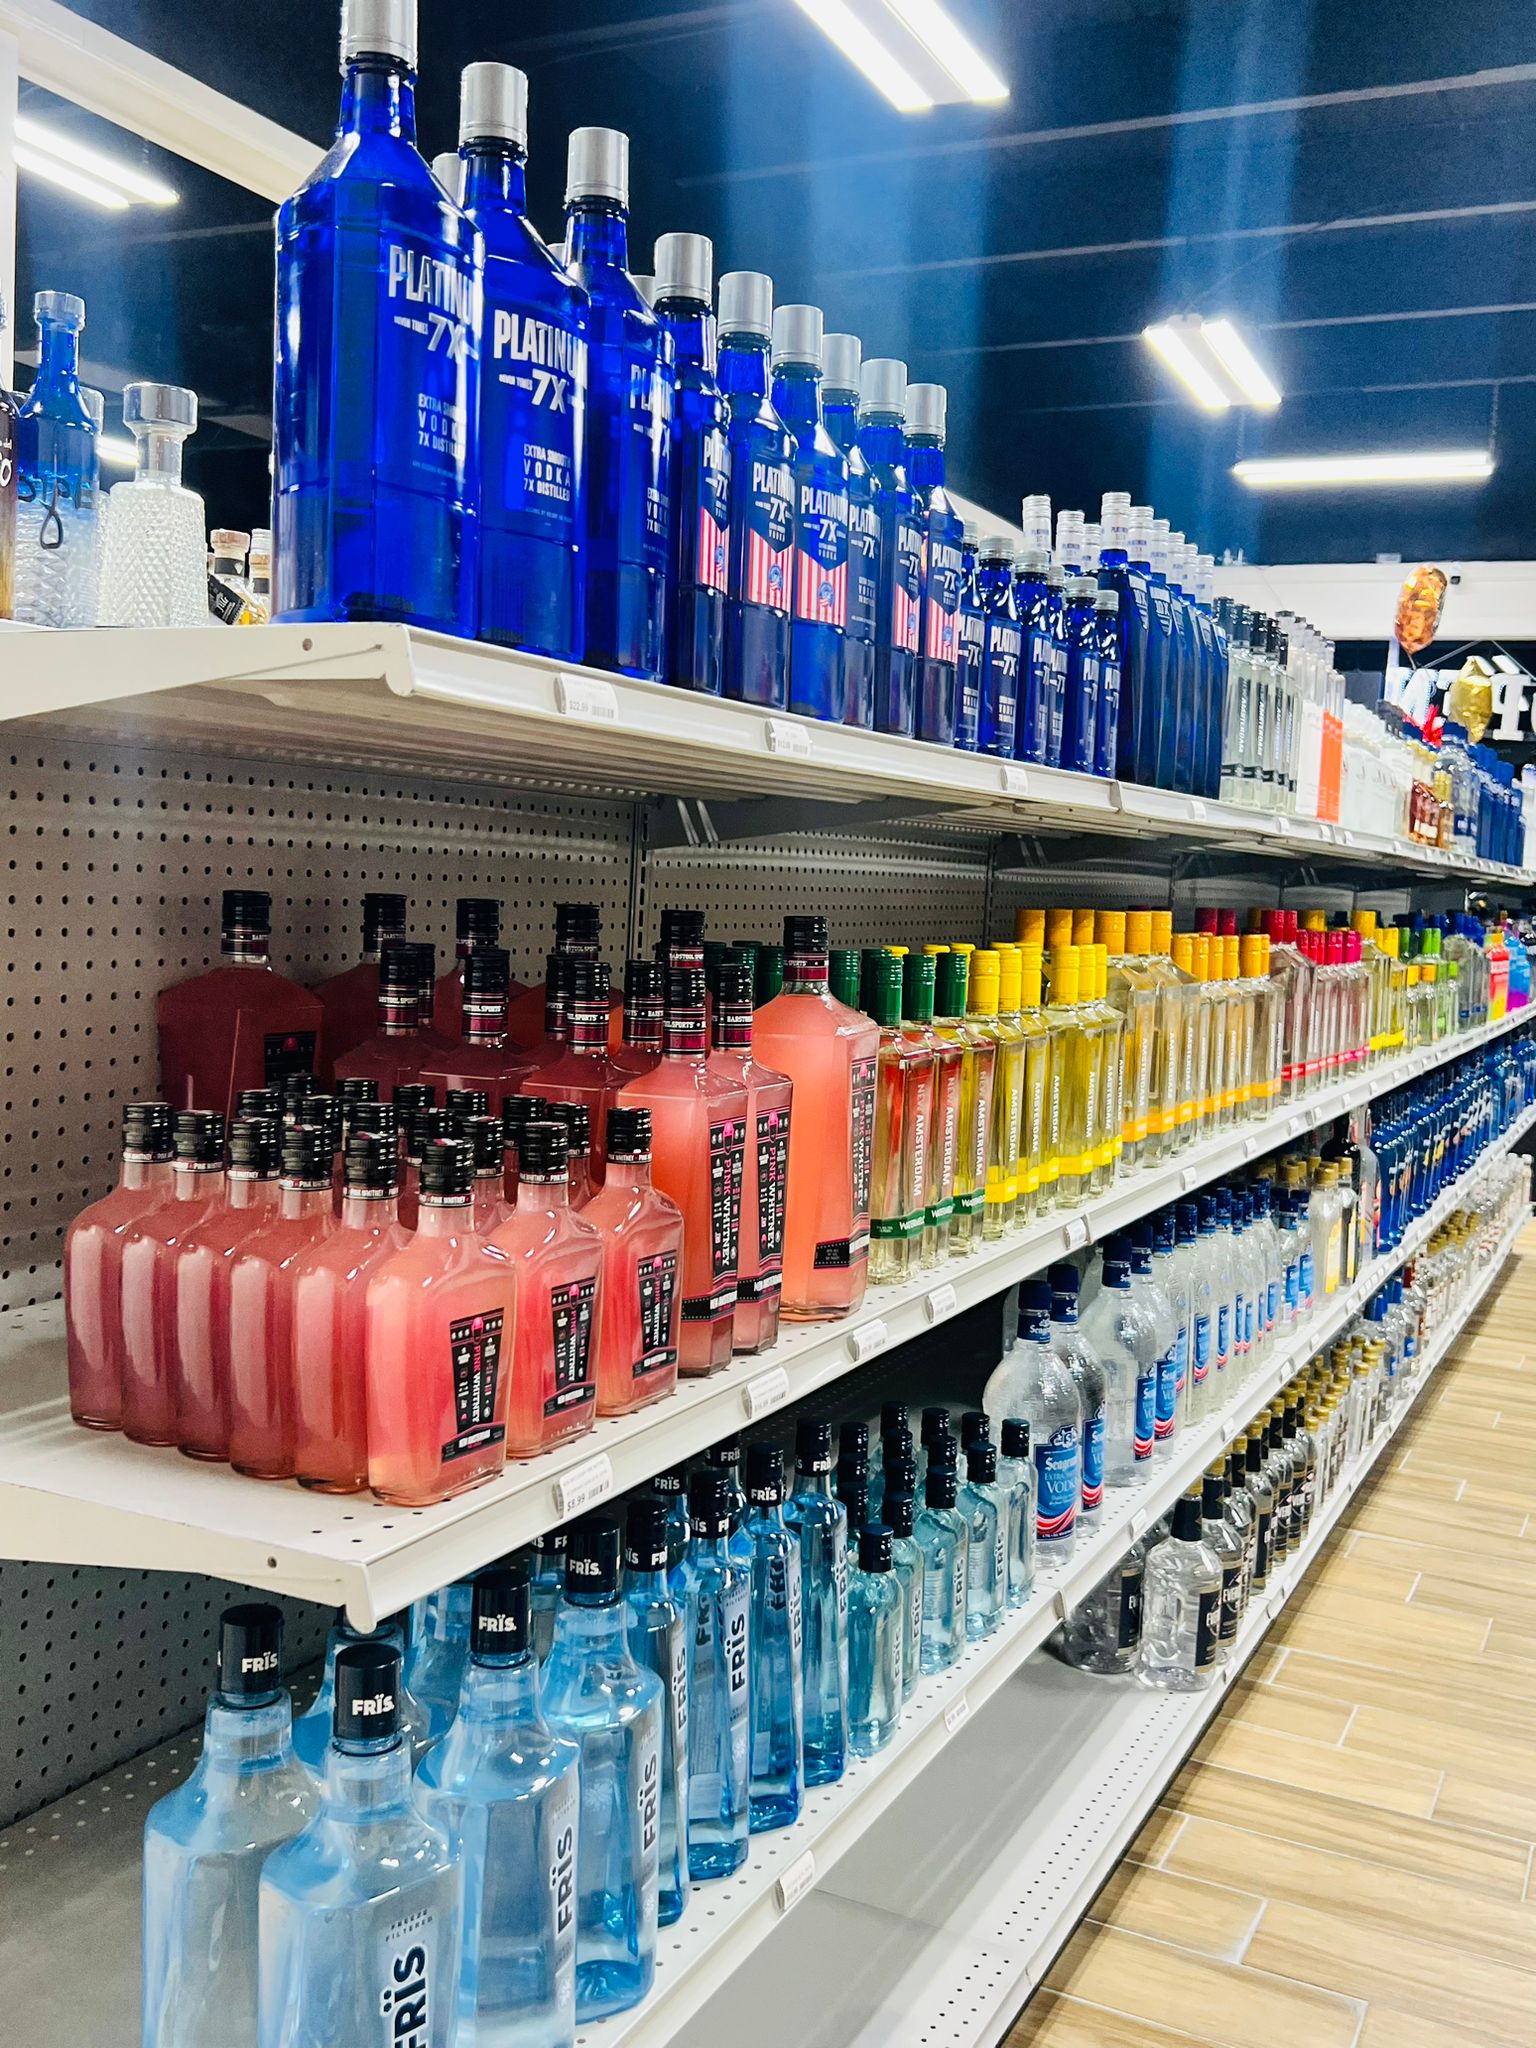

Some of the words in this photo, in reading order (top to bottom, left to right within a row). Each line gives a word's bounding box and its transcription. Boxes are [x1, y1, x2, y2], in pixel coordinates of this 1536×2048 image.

[531, 368, 566, 414] 7X
[523, 458, 571, 487] VODKA
[523, 477, 534, 492] 7X
[770, 496, 787, 525] 7X
[819, 518, 838, 543] 7X
[862, 535, 875, 559] 7X
[1003, 655, 1017, 677] 7X
[1009, 1088, 1018, 1162] AMSTERDAM
[1032, 1082, 1041, 1152] AMSTERDAM
[1052, 1075, 1060, 1144] AMSTERDAM
[1086, 1071, 1095, 1137] AMSTERDAM
[913, 1114, 925, 1197] AMSTERDAM
[943, 1106, 954, 1185] AMSTERDAM
[976, 1099, 986, 1177] AMSTERDAM
[723, 1158, 732, 1196] PINK
[722, 1196, 731, 1266] WHITNEY
[767, 1181, 776, 1249] WHITNEY
[473, 1344, 481, 1372] PINK
[471, 1371, 481, 1423] WHITNEY
[726, 1613, 746, 1693] FRÏS
[385, 1915, 434, 1943] FILTERED
[391, 1908, 429, 1930] FREEZE
